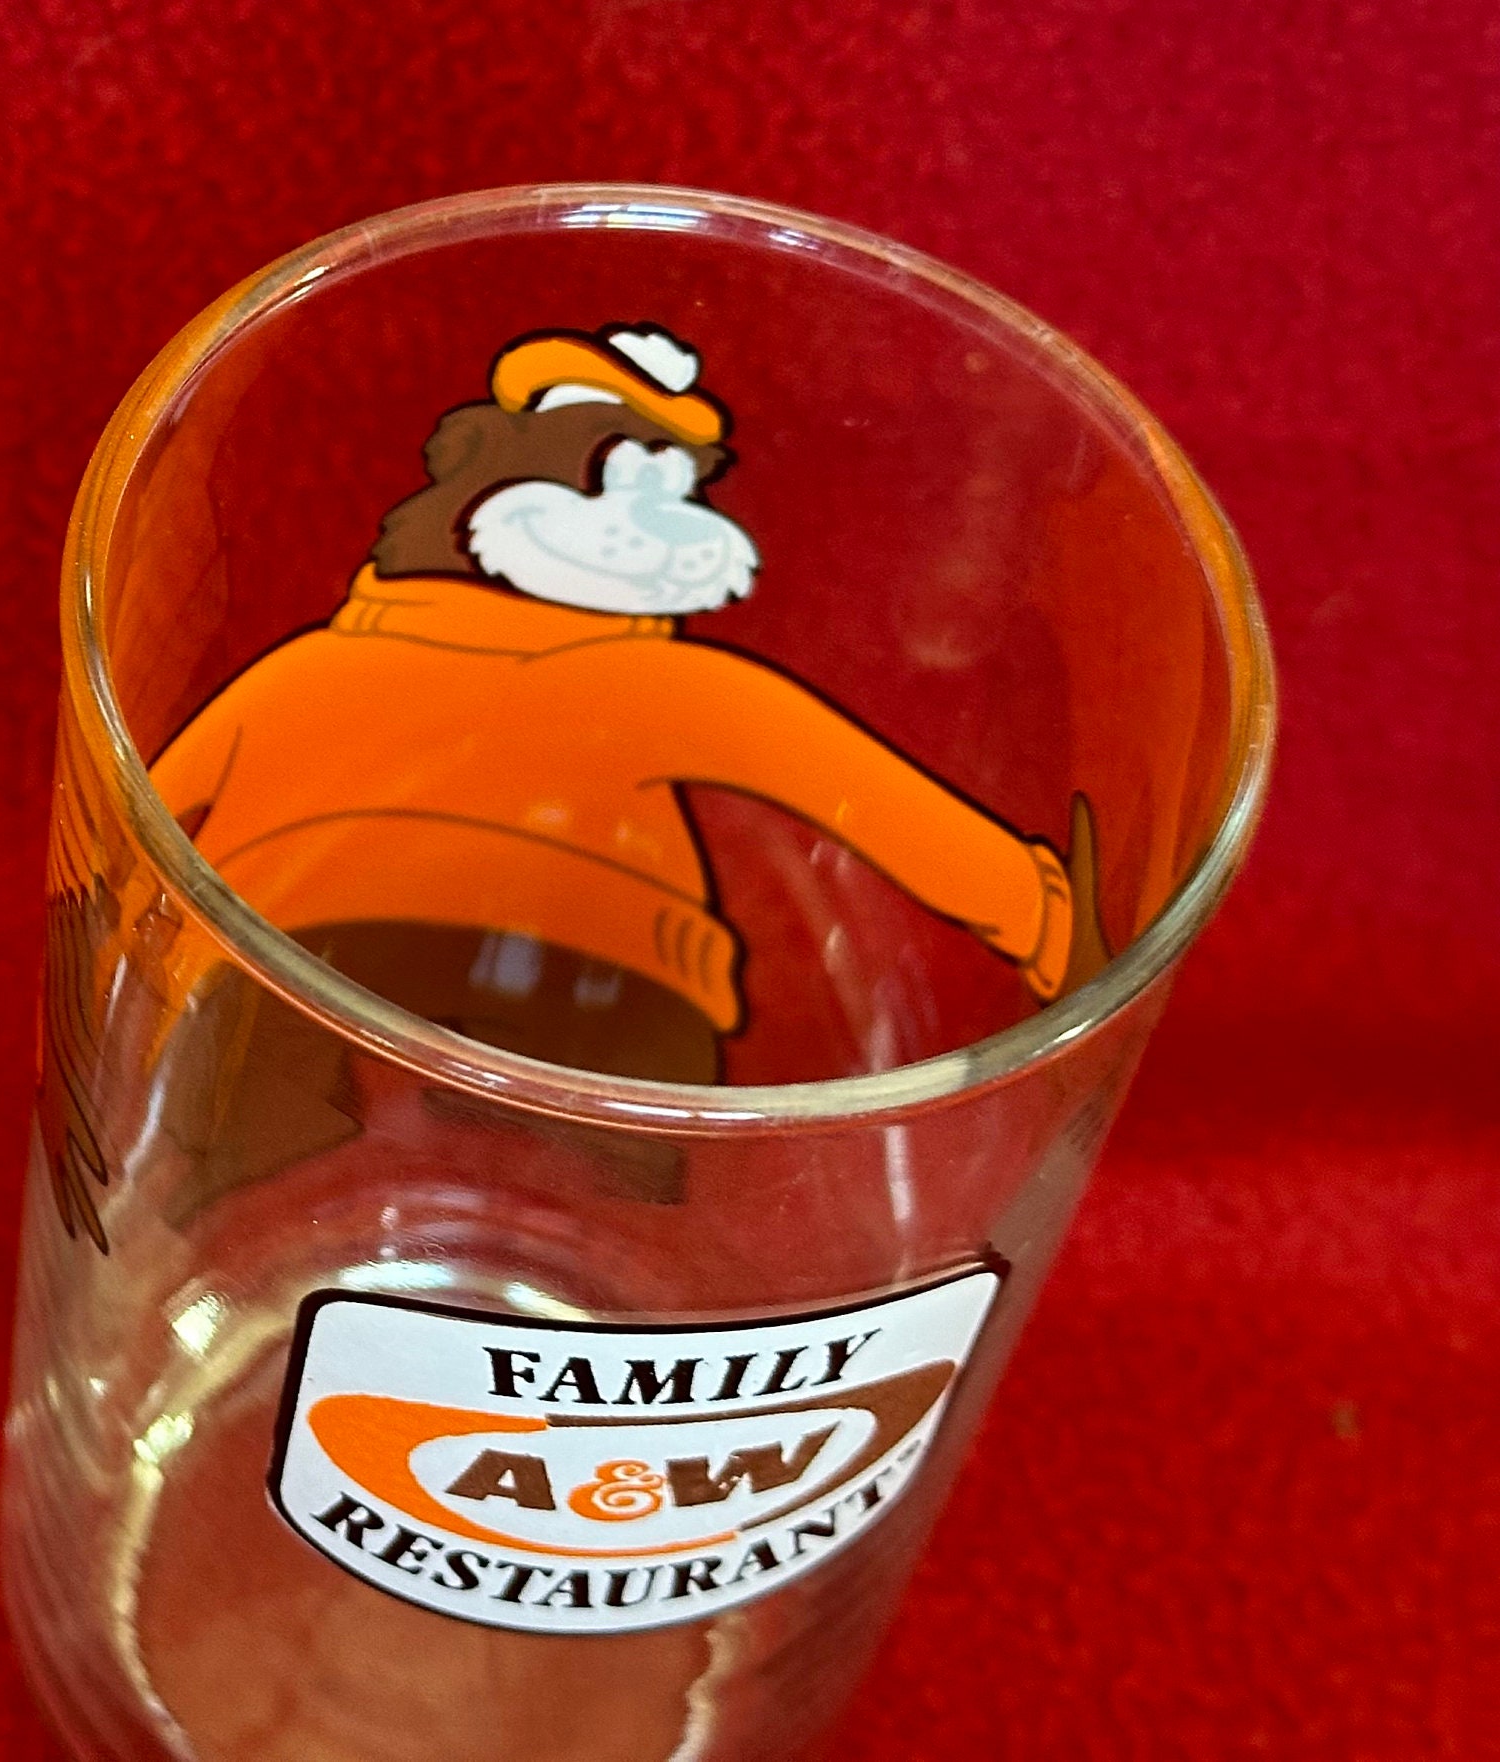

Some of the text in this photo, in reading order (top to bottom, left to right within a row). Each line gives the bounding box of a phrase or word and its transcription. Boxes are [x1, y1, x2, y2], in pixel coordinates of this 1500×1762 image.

[483, 1328, 882, 1406] FAMILY
[446, 1420, 843, 1522] A&W
[312, 1465, 893, 1609] RESTAURANT
